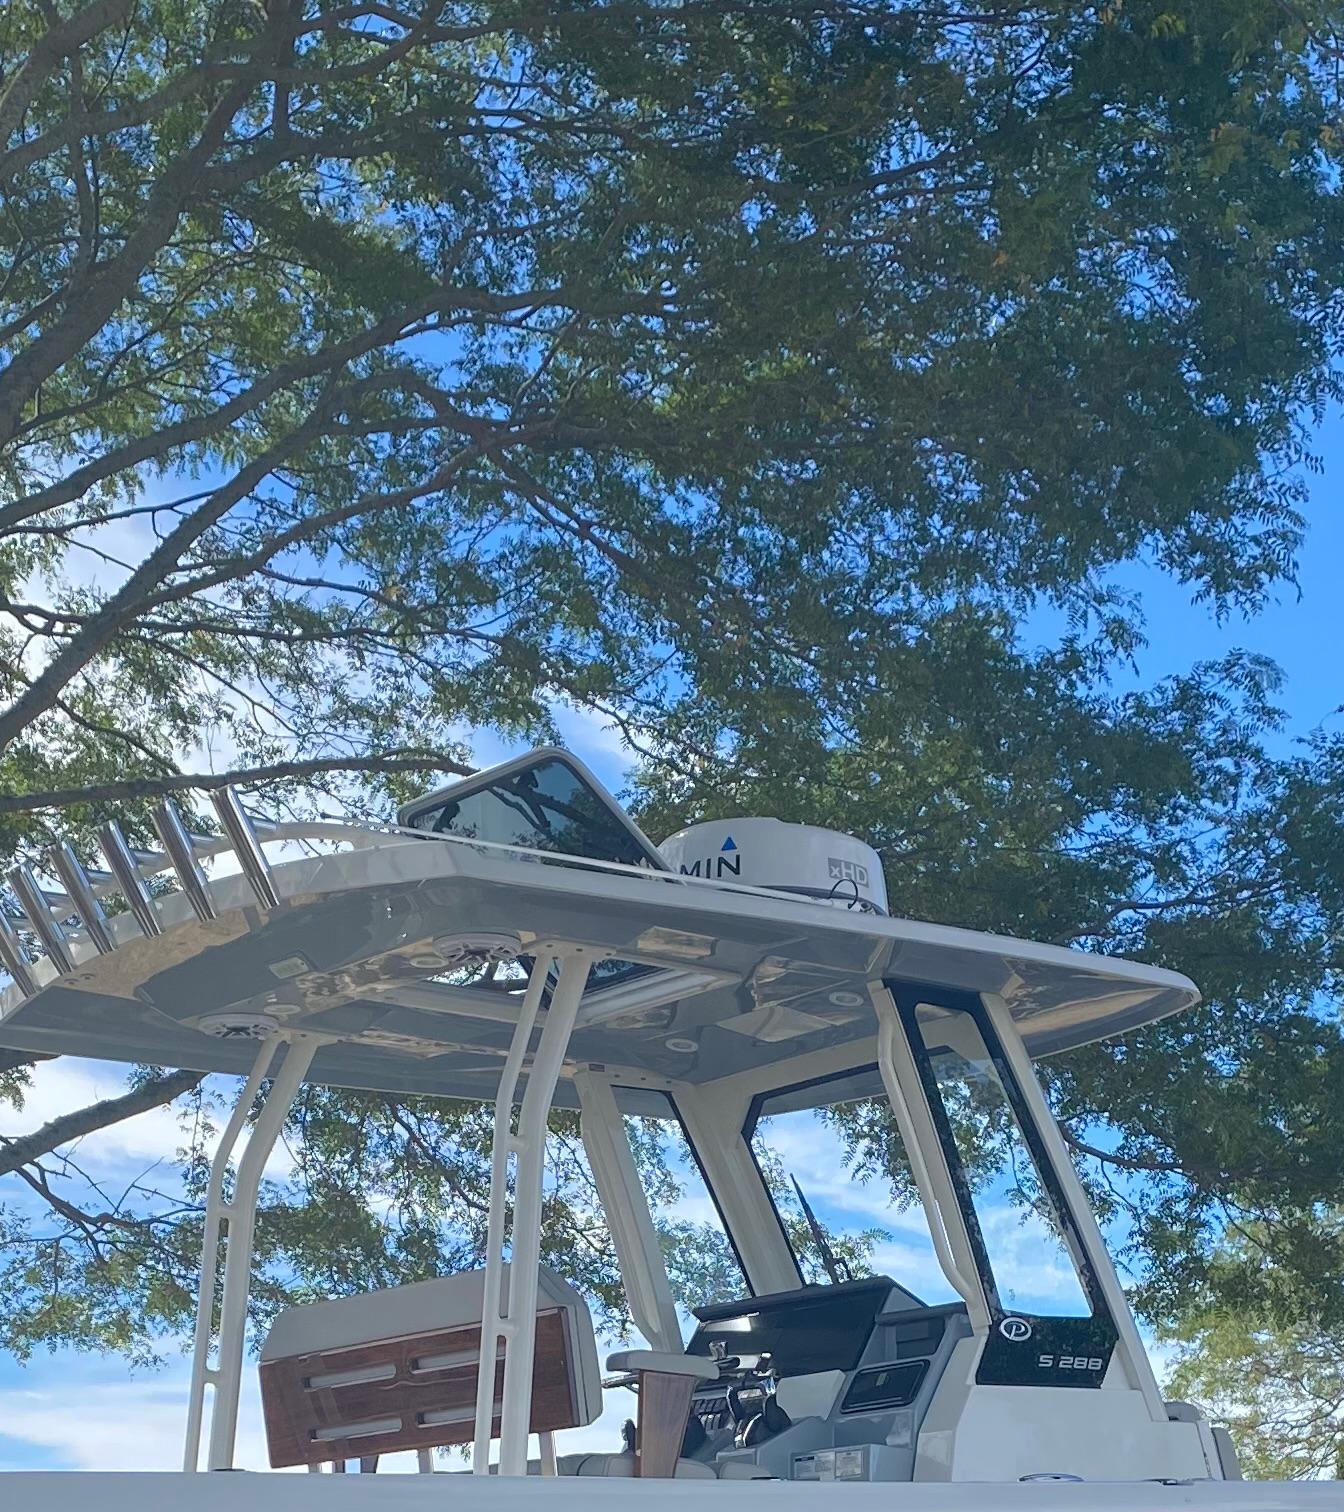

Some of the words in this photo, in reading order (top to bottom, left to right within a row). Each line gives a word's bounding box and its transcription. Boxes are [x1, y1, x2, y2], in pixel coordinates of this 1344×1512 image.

[830, 861, 869, 886] xHD
[1038, 1354, 1054, 1368] S
[1058, 1356, 1103, 1370] 288
